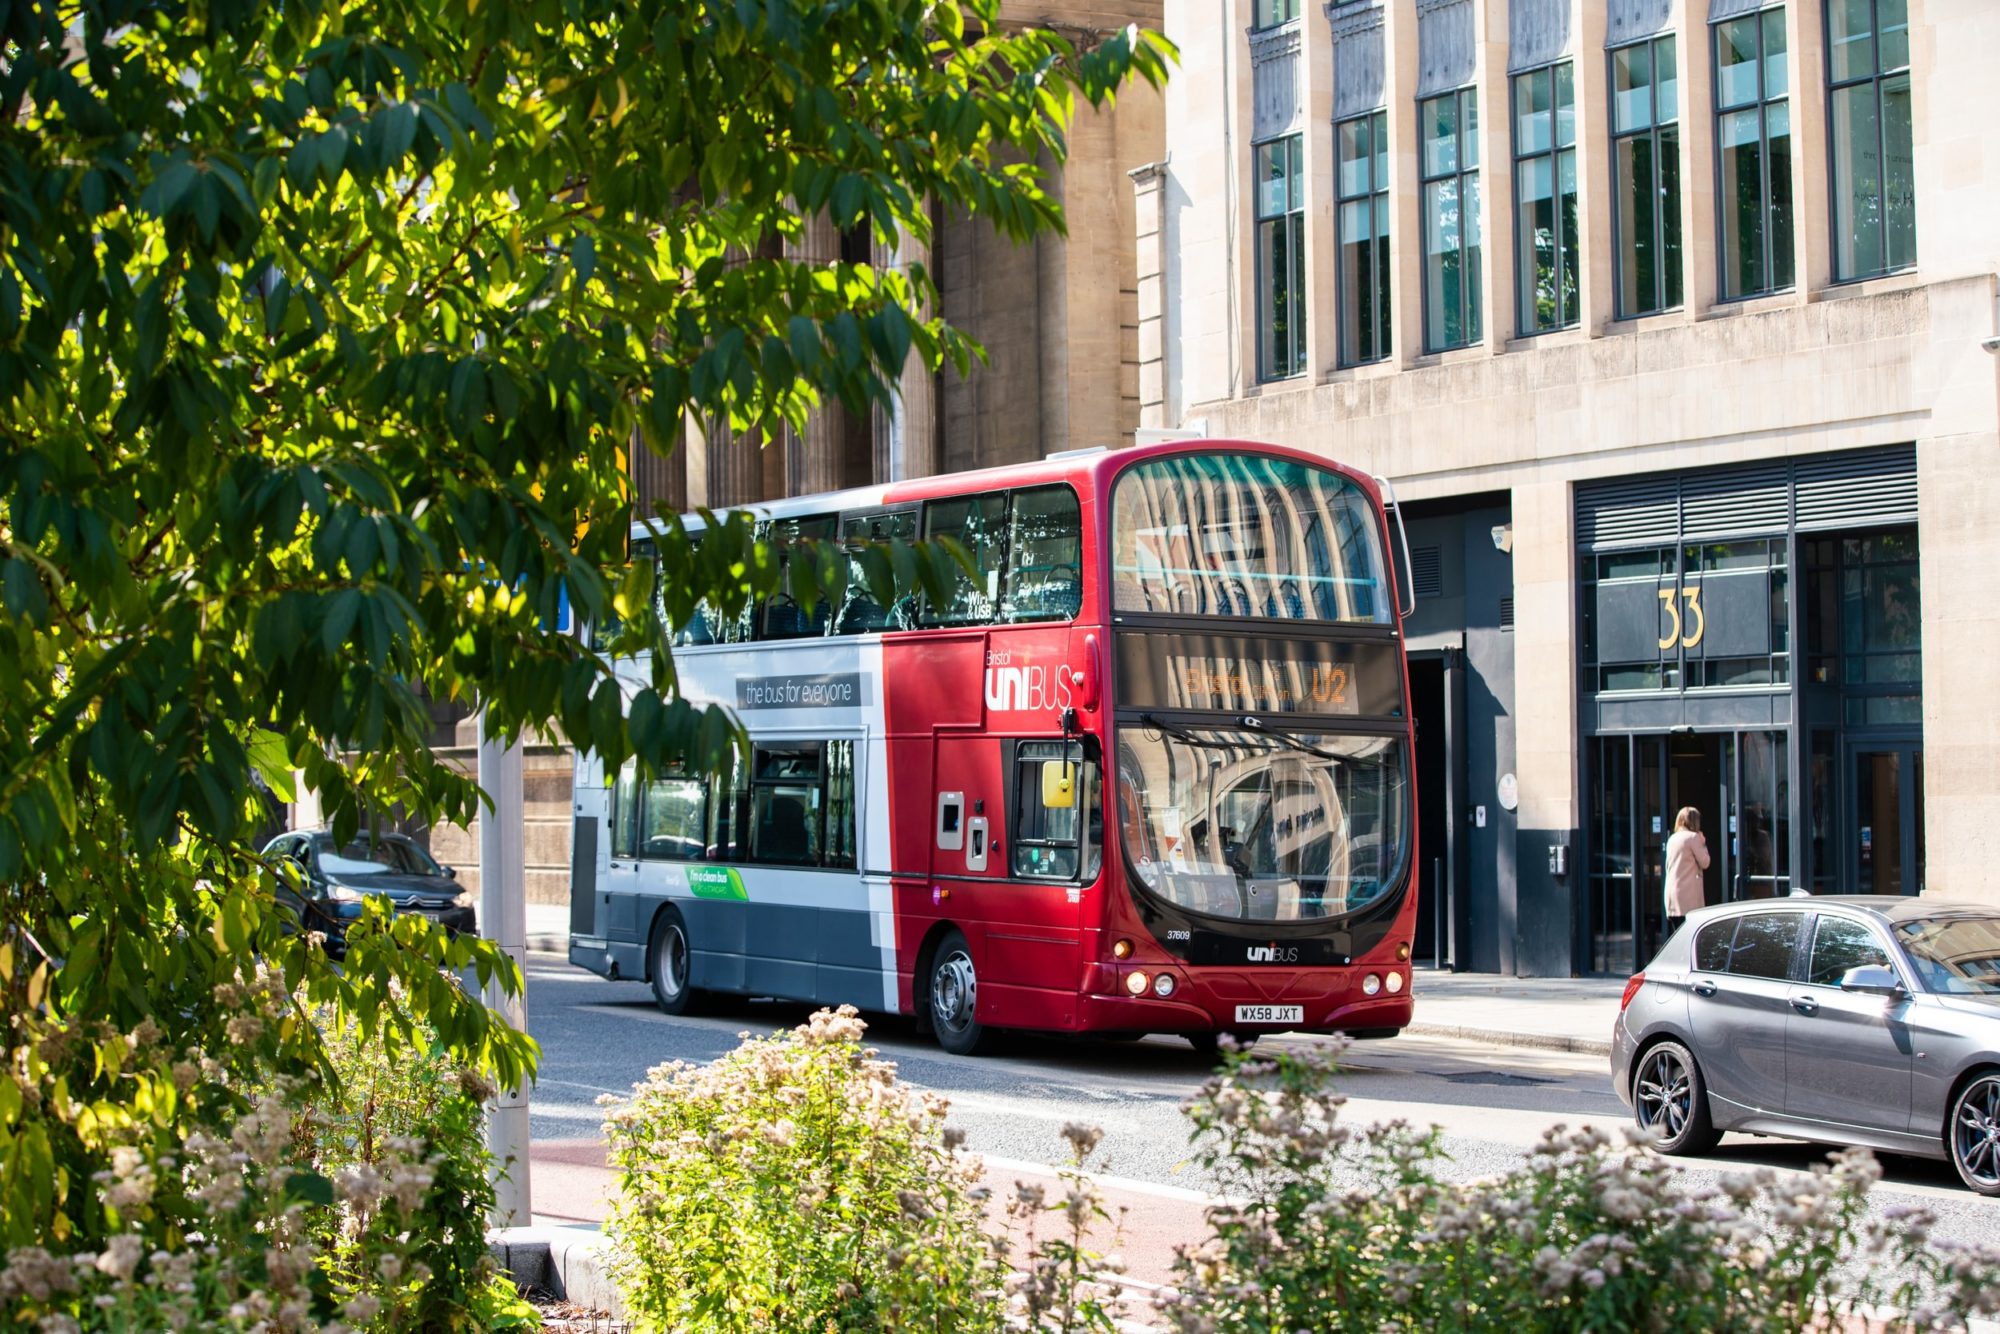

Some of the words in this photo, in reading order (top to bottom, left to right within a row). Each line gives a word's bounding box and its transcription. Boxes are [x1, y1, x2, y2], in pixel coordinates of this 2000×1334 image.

[974, 605, 992, 619] USB
[1659, 587, 1704, 650] 33
[986, 650, 1011, 665] Bristol
[746, 682, 763, 704] the
[765, 681, 784, 703] bus
[786, 680, 800, 702] for
[801, 683, 851, 705] everyone
[1312, 668, 1346, 703] U2
[1167, 930, 1190, 940] 37609
[1241, 1007, 1272, 1020] WX58
[1276, 1007, 1298, 1020] JXT
